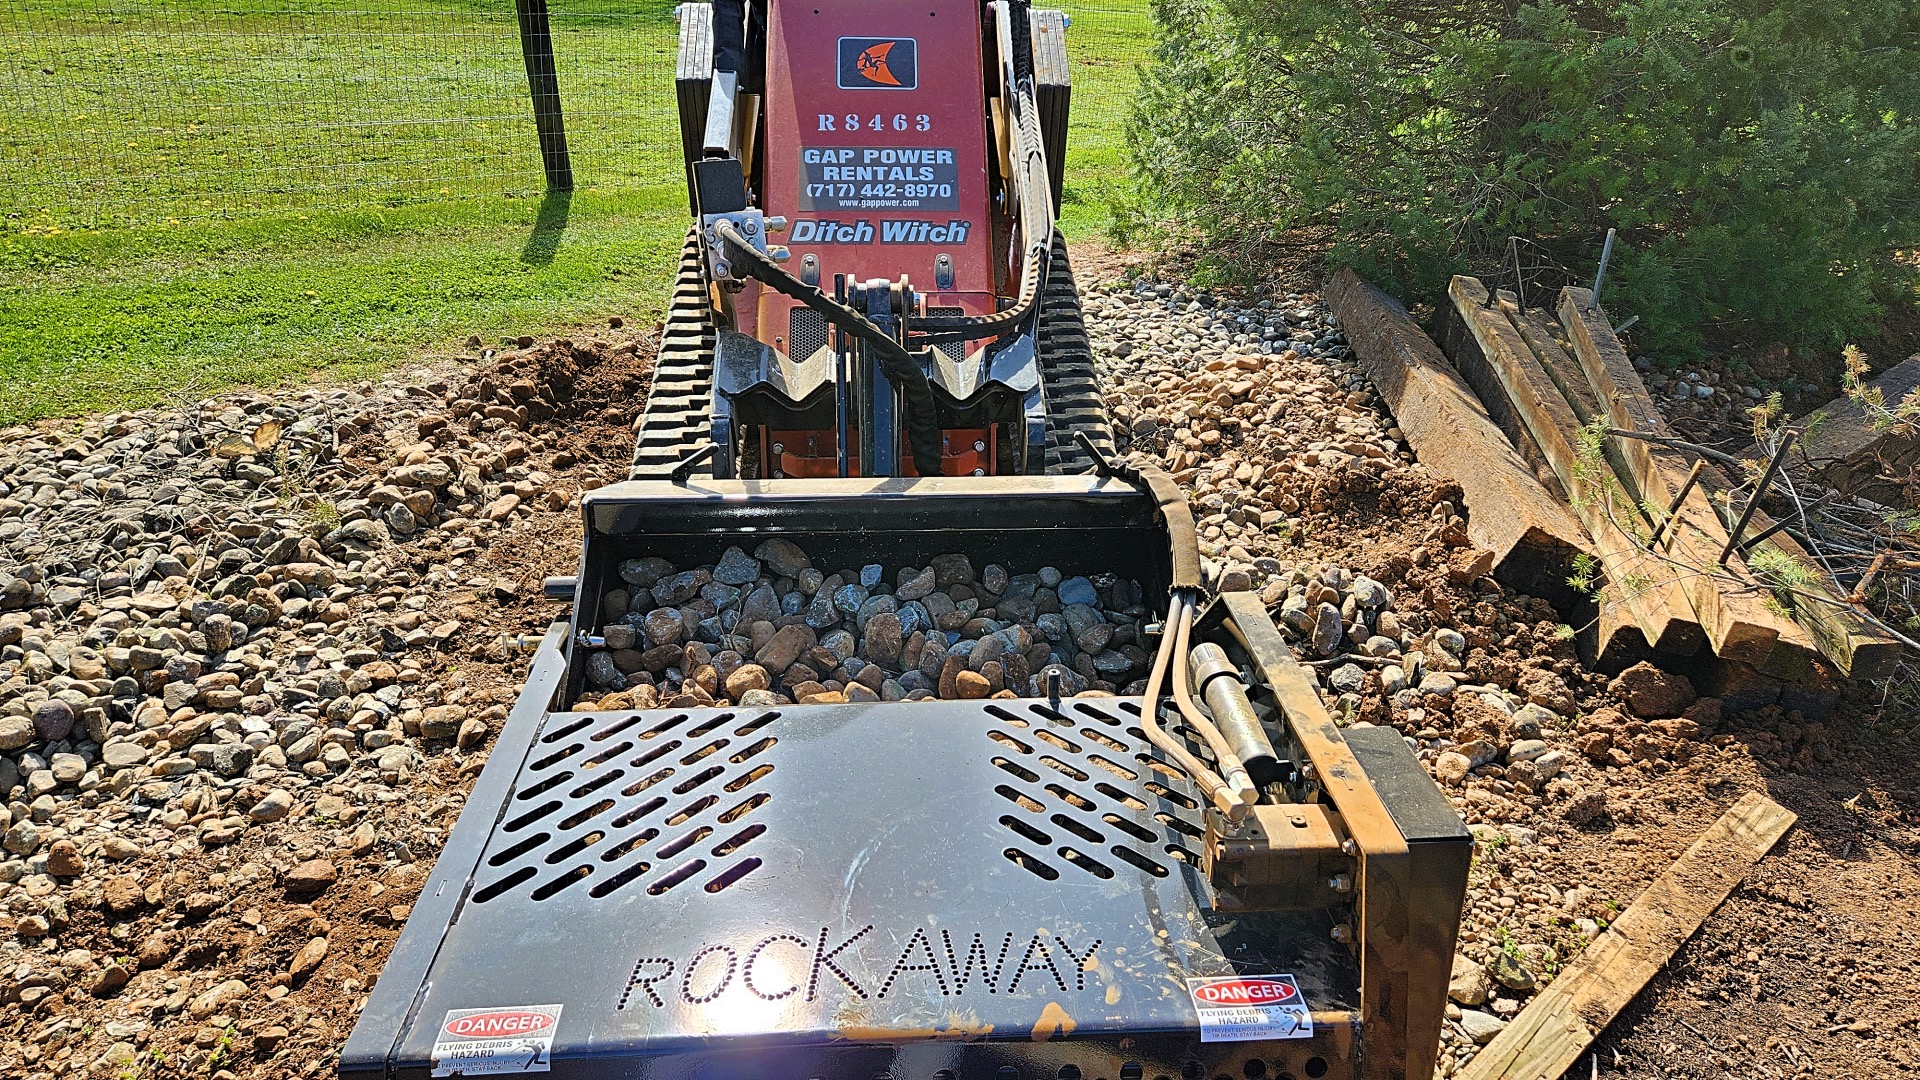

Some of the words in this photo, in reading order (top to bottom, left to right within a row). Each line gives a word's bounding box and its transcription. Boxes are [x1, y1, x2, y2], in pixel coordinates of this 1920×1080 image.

[804, 149, 855, 164] GAP
[864, 149, 953, 164] POWER
[823, 166, 934, 181] RENTALS
[806, 183, 855, 197] (717)
[861, 183, 952, 198] 442-8970
[838, 199, 920, 208] www.gappower.com
[791, 221, 873, 243] Ditch
[1203, 984, 1288, 1001] DANGER
[1200, 1009, 1234, 1017] FLYING
[1236, 1007, 1272, 1016] DEBRIS
[455, 1014, 543, 1033] DANGER
[1218, 1016, 1259, 1025] HAZARD
[436, 1043, 473, 1052] FLYING
[475, 1041, 513, 1050] DEBRIS
[450, 1049, 495, 1060] HAZARD
